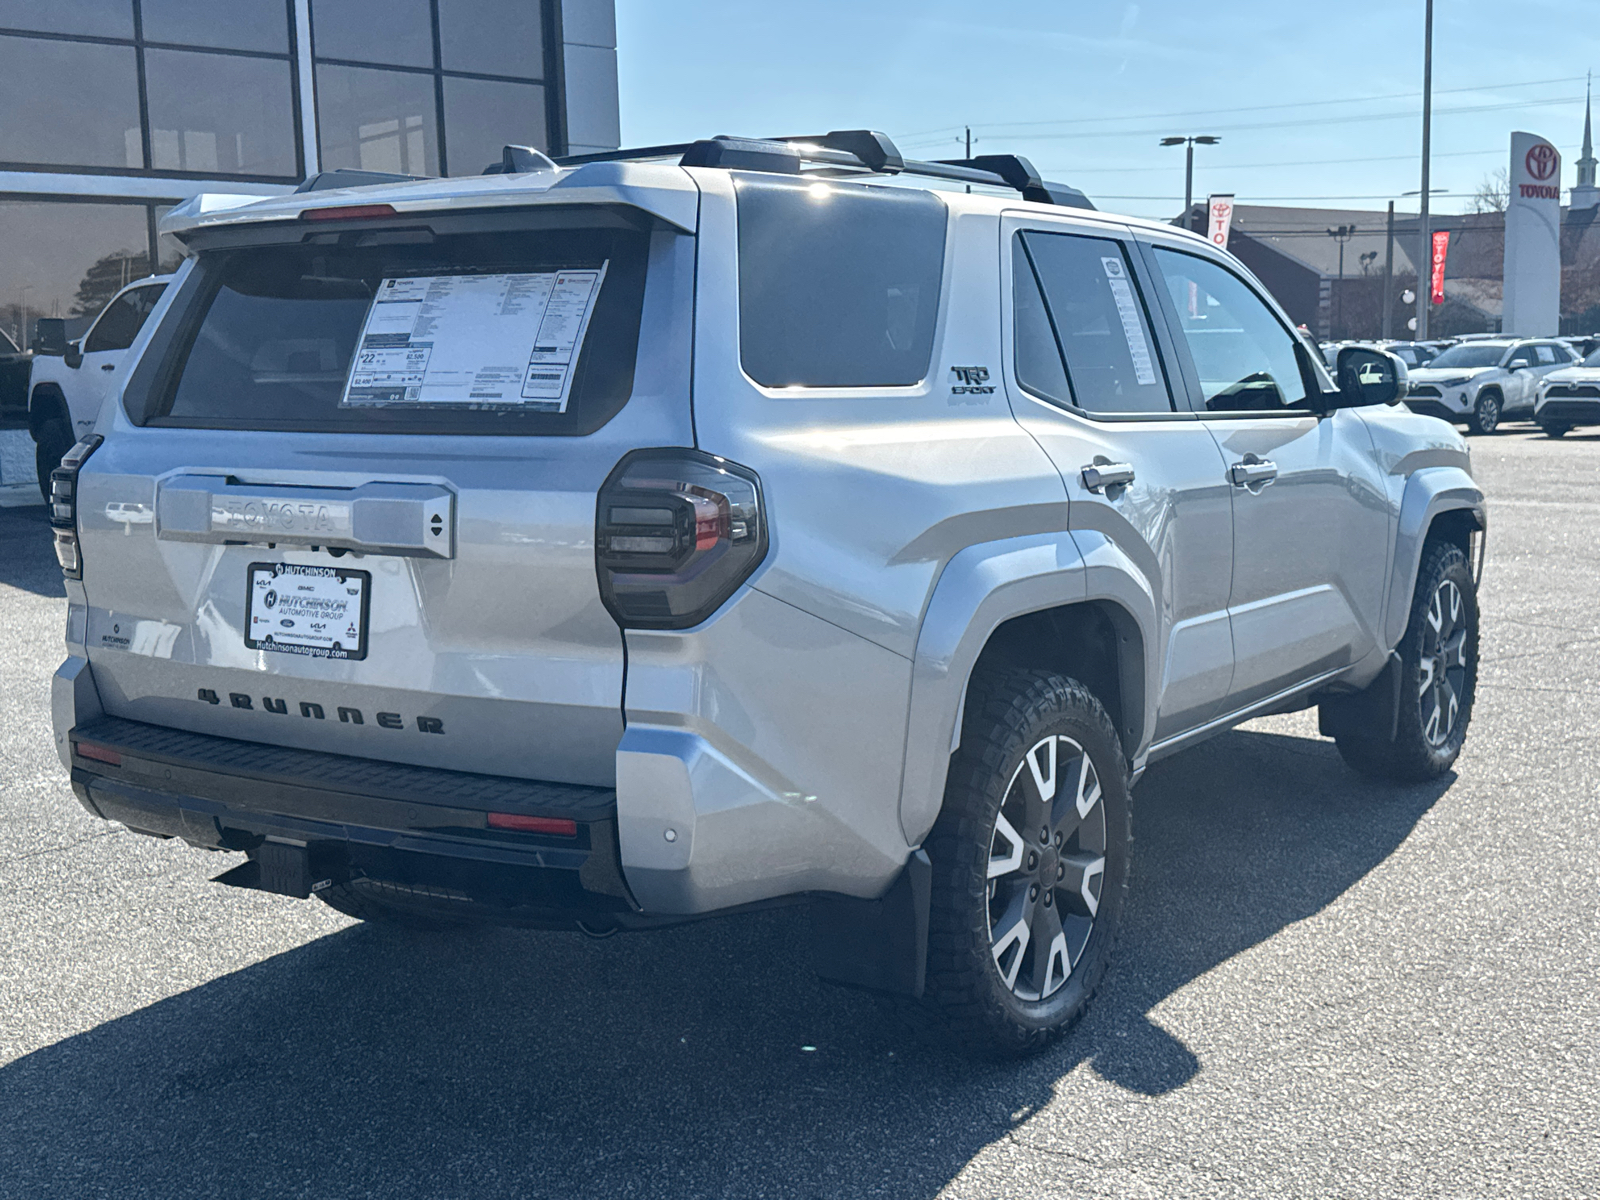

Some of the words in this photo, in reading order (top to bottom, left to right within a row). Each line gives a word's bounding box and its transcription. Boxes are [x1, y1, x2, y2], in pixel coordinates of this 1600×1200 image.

[1519, 184, 1560, 200] TOYOTA
[950, 366, 990, 385] TRD
[951, 386, 997, 394] SPORT
[228, 501, 333, 531] TOYOTA
[285, 564, 337, 578] HUTCHINSON
[279, 594, 349, 612] HUTCHINSON
[279, 607, 319, 619] AUTOMOTIVE
[320, 611, 344, 620] GROUP
[256, 640, 348, 659] Hutchinsonautogroup.com
[197, 688, 446, 735] 4RUNNER
